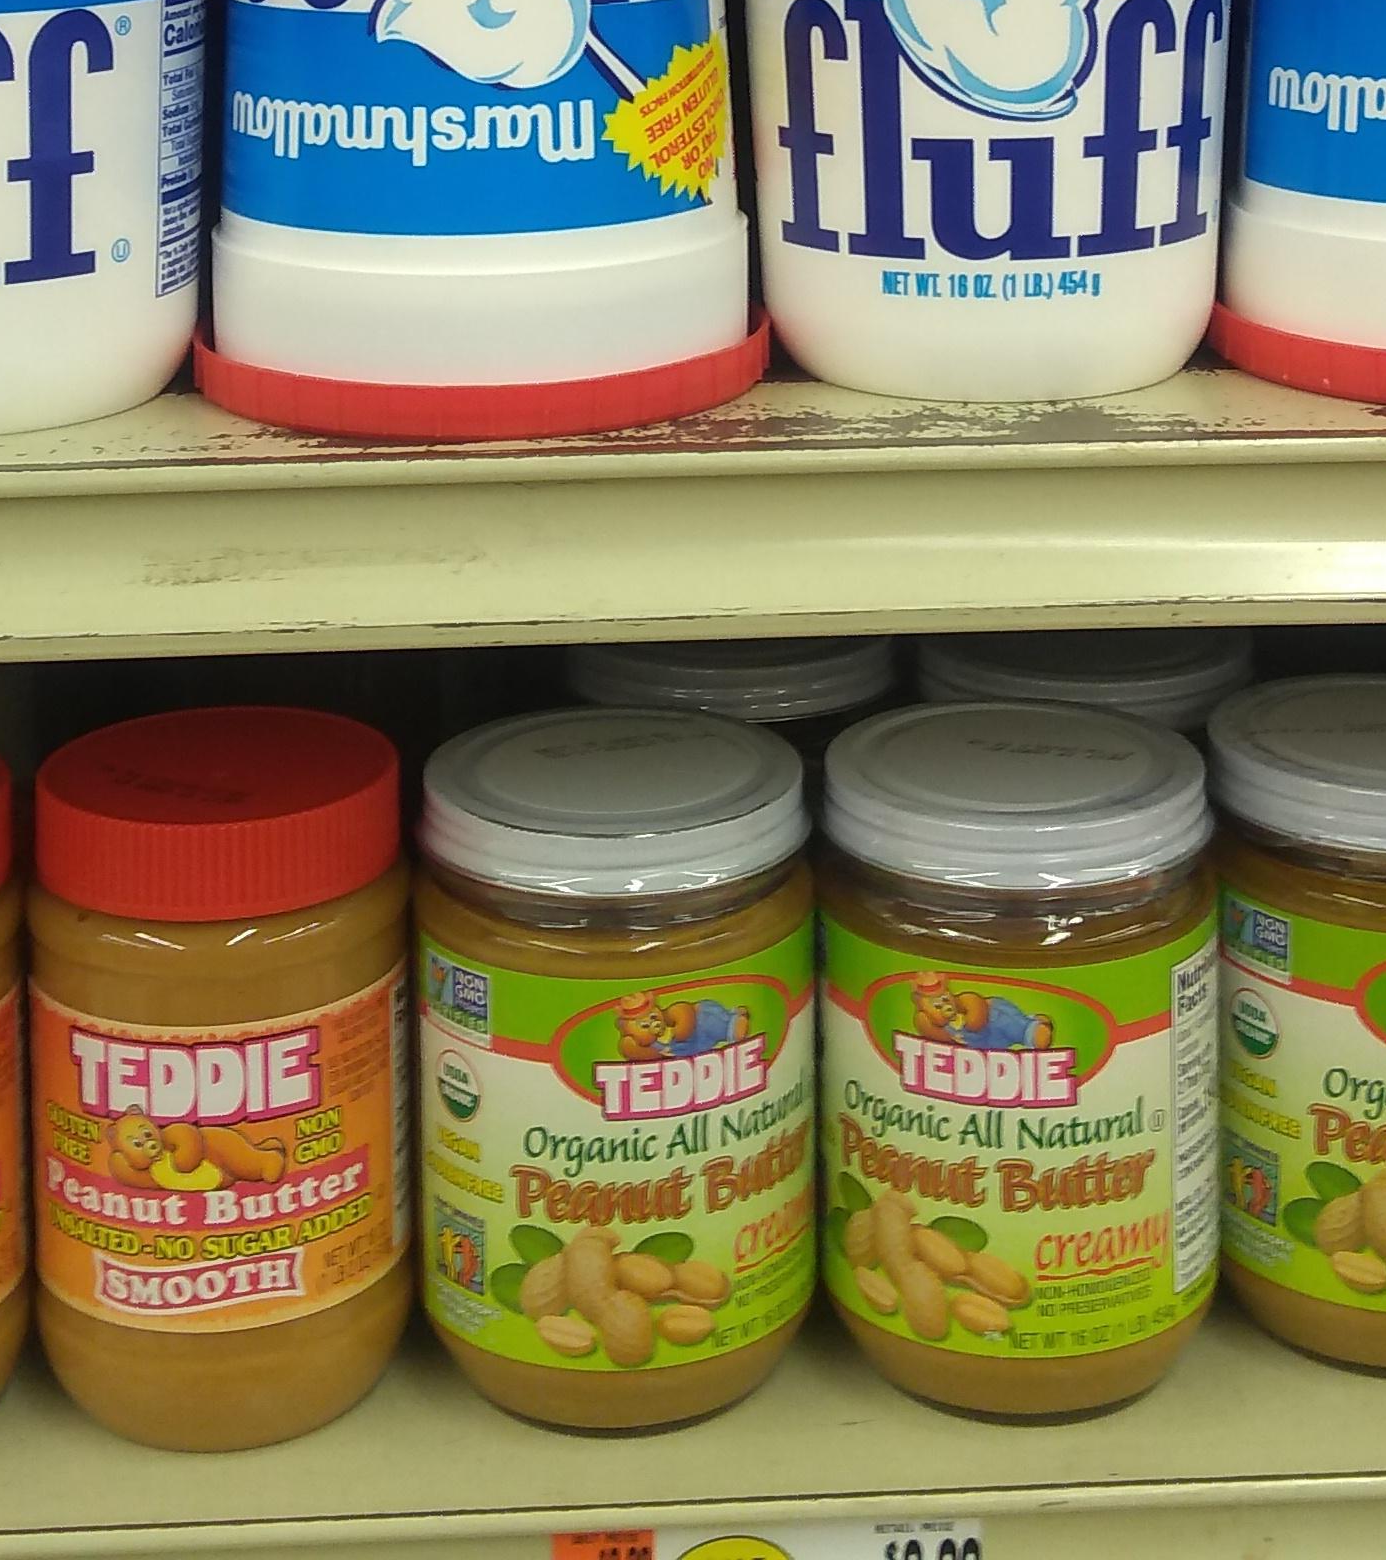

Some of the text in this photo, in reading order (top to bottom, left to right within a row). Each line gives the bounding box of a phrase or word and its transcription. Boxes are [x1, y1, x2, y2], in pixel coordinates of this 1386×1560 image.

[232, 90, 595, 166] Marshmallow
[645, 108, 682, 143] FREE
[882, 271, 909, 296] NET
[948, 275, 969, 298] 16
[1058, 271, 1088, 294] 454
[455, 970, 486, 992] NON
[455, 985, 486, 1005] GMO
[72, 1032, 312, 1119] TEDDIE
[595, 1042, 765, 1115] TEDDIE
[895, 1034, 1074, 1101] TEDDIE
[523, 1126, 658, 1177] Organic
[666, 1118, 707, 1160] All
[844, 1079, 1145, 1150] Organic All Natural
[47, 1158, 188, 1225] Peanut
[203, 1161, 364, 1226] Butter
[840, 1112, 1156, 1212] Peanut Butter
[509, 1164, 695, 1227] Peanut
[1034, 1208, 1170, 1274] creamy
[109, 1260, 292, 1308] SMOOTH
